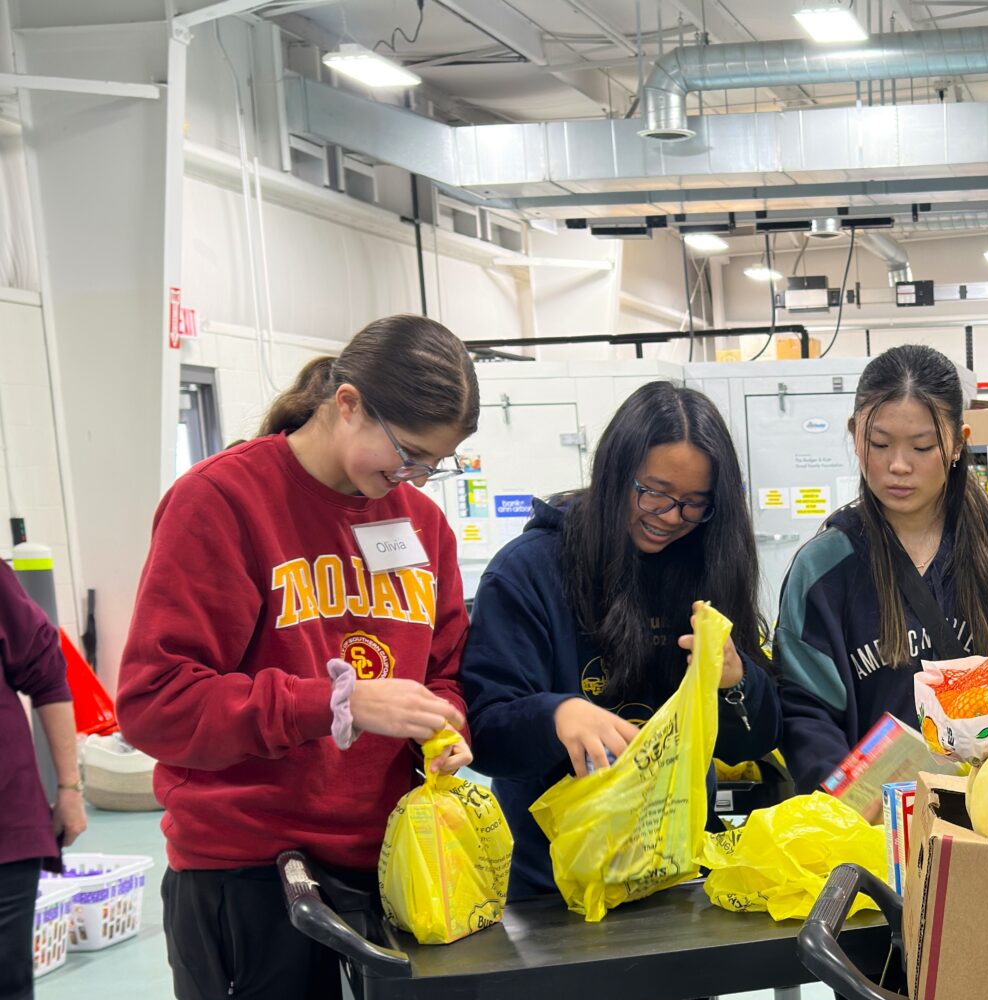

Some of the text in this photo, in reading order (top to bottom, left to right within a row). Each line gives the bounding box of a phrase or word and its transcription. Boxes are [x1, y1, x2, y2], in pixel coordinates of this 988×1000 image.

[376, 539, 408, 554] Olivia
[349, 636, 382, 652] SOUTHERN
[350, 646, 374, 680] SC
